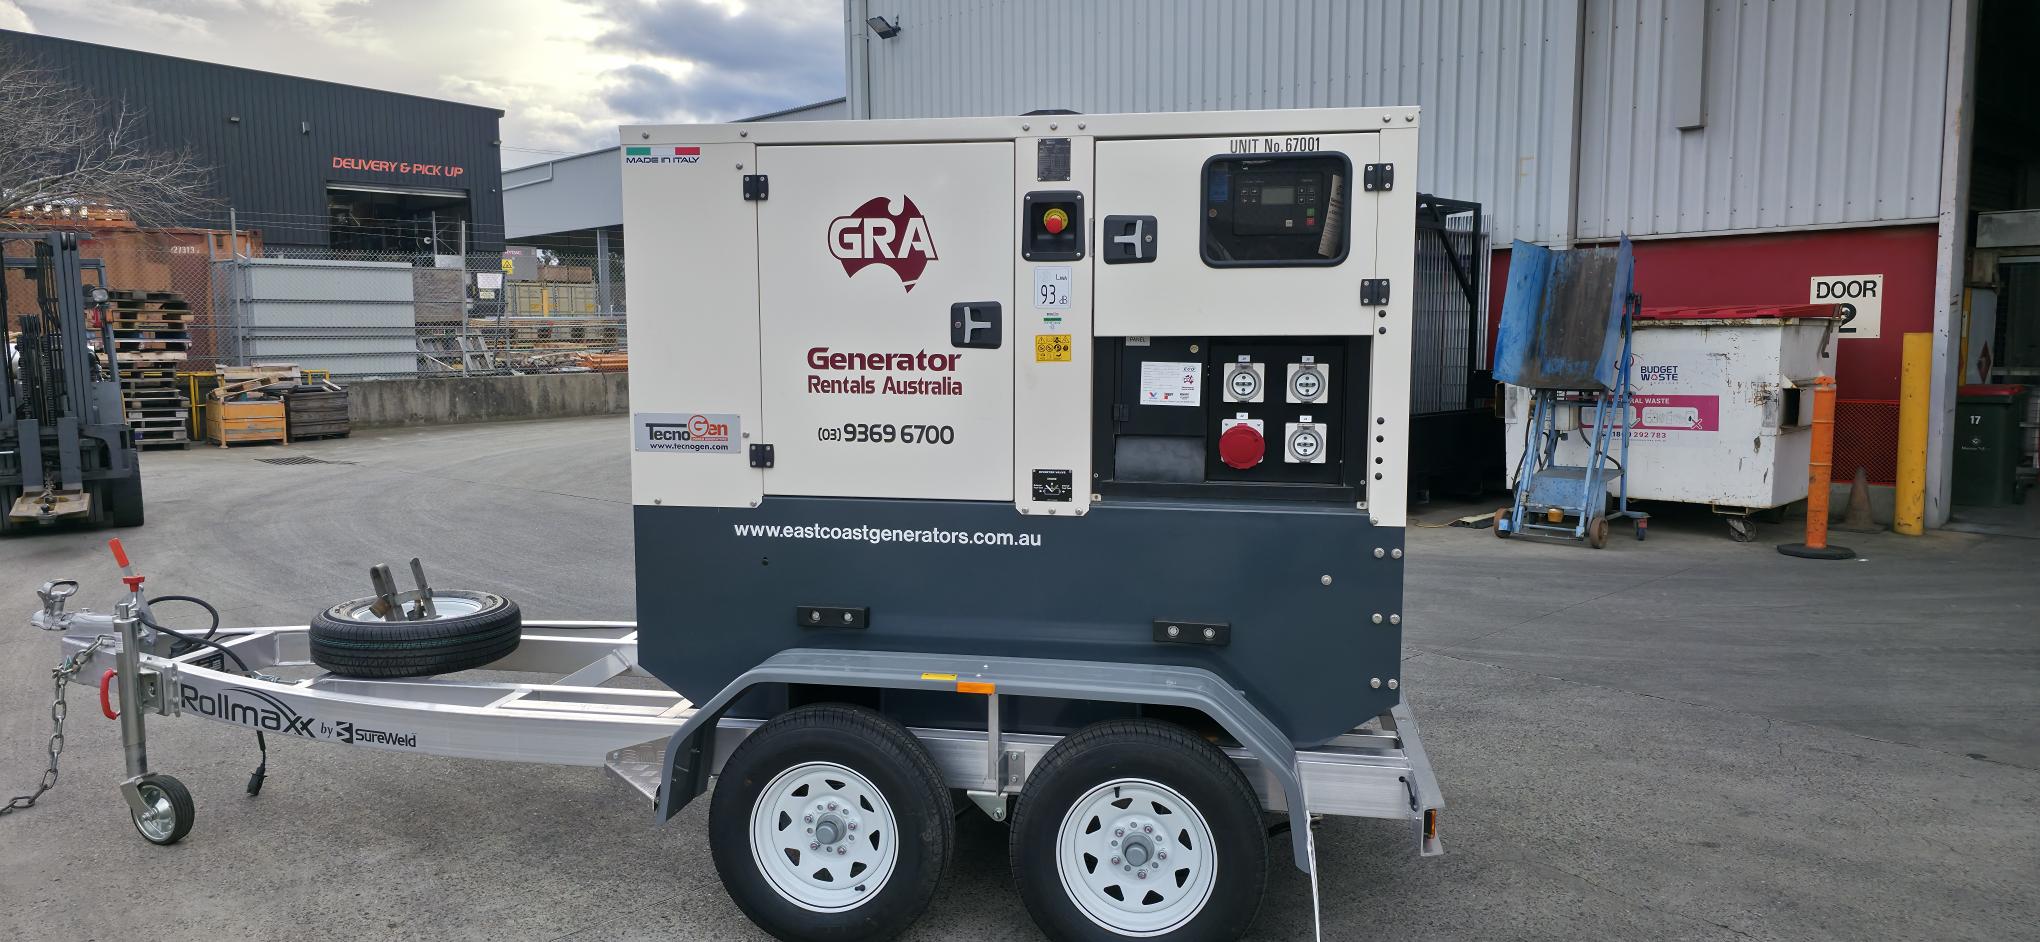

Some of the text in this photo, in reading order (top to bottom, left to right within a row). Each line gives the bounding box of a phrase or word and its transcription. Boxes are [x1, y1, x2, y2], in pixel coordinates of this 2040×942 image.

[1230, 139, 1259, 154] UNIT
[1285, 137, 1320, 152] 67001
[332, 157, 464, 178] DELIVERY & PICK UP
[828, 216, 938, 260] GRA
[1041, 284, 1056, 305] 93
[1816, 279, 1877, 299] DOOR
[1838, 302, 1857, 333] 2
[807, 346, 963, 372] Generator
[1640, 365, 1679, 374] BUDGET
[807, 374, 963, 396] Rentals Australia
[1640, 373, 1679, 381] WASTE
[1645, 397, 1670, 405] WASTE
[1970, 415, 1981, 425] 17
[817, 423, 955, 445] (03) 9369 6700
[650, 443, 729, 452] www.tecnogen.com
[734, 523, 1042, 546] www.eastcoastgenerators.com.au
[181, 684, 417, 748] Rollmaxx by SureWeld
